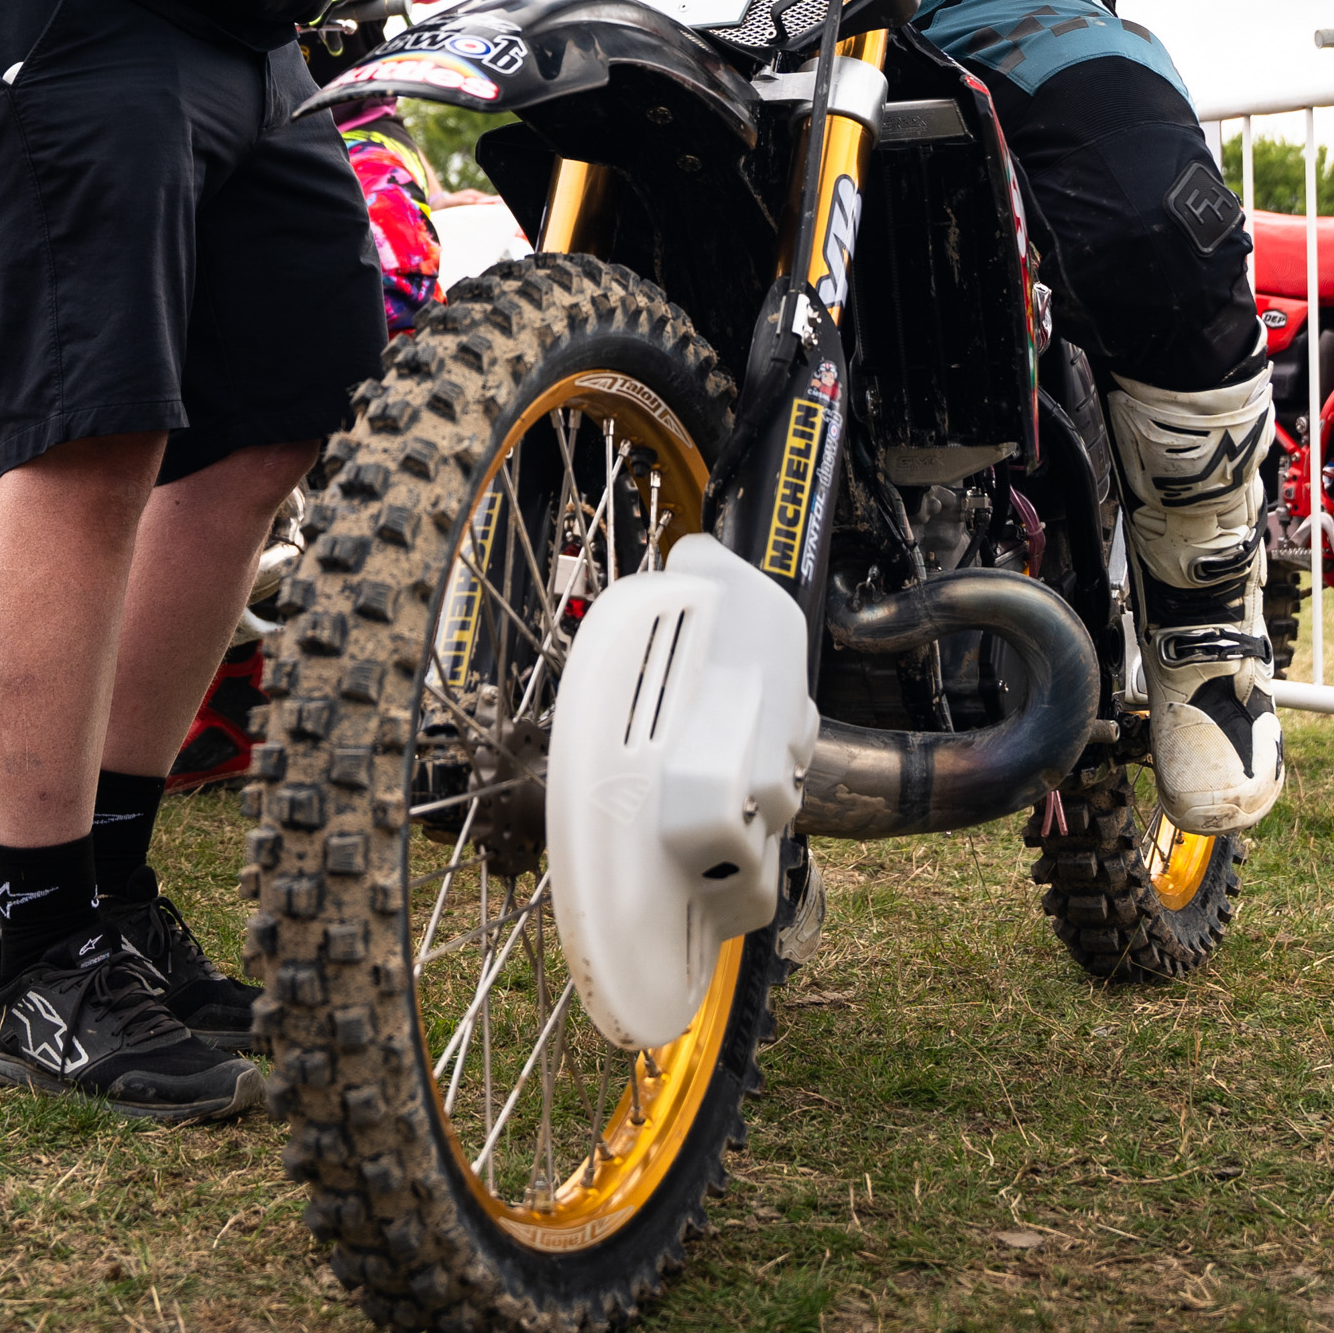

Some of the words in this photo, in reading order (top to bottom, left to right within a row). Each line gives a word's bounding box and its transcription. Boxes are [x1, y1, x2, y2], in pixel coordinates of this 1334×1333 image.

[1264, 314, 1285, 323] DEP
[618, 377, 662, 418] Talon
[768, 403, 820, 574] MICHELIN
[800, 488, 826, 582] SYNTOL
